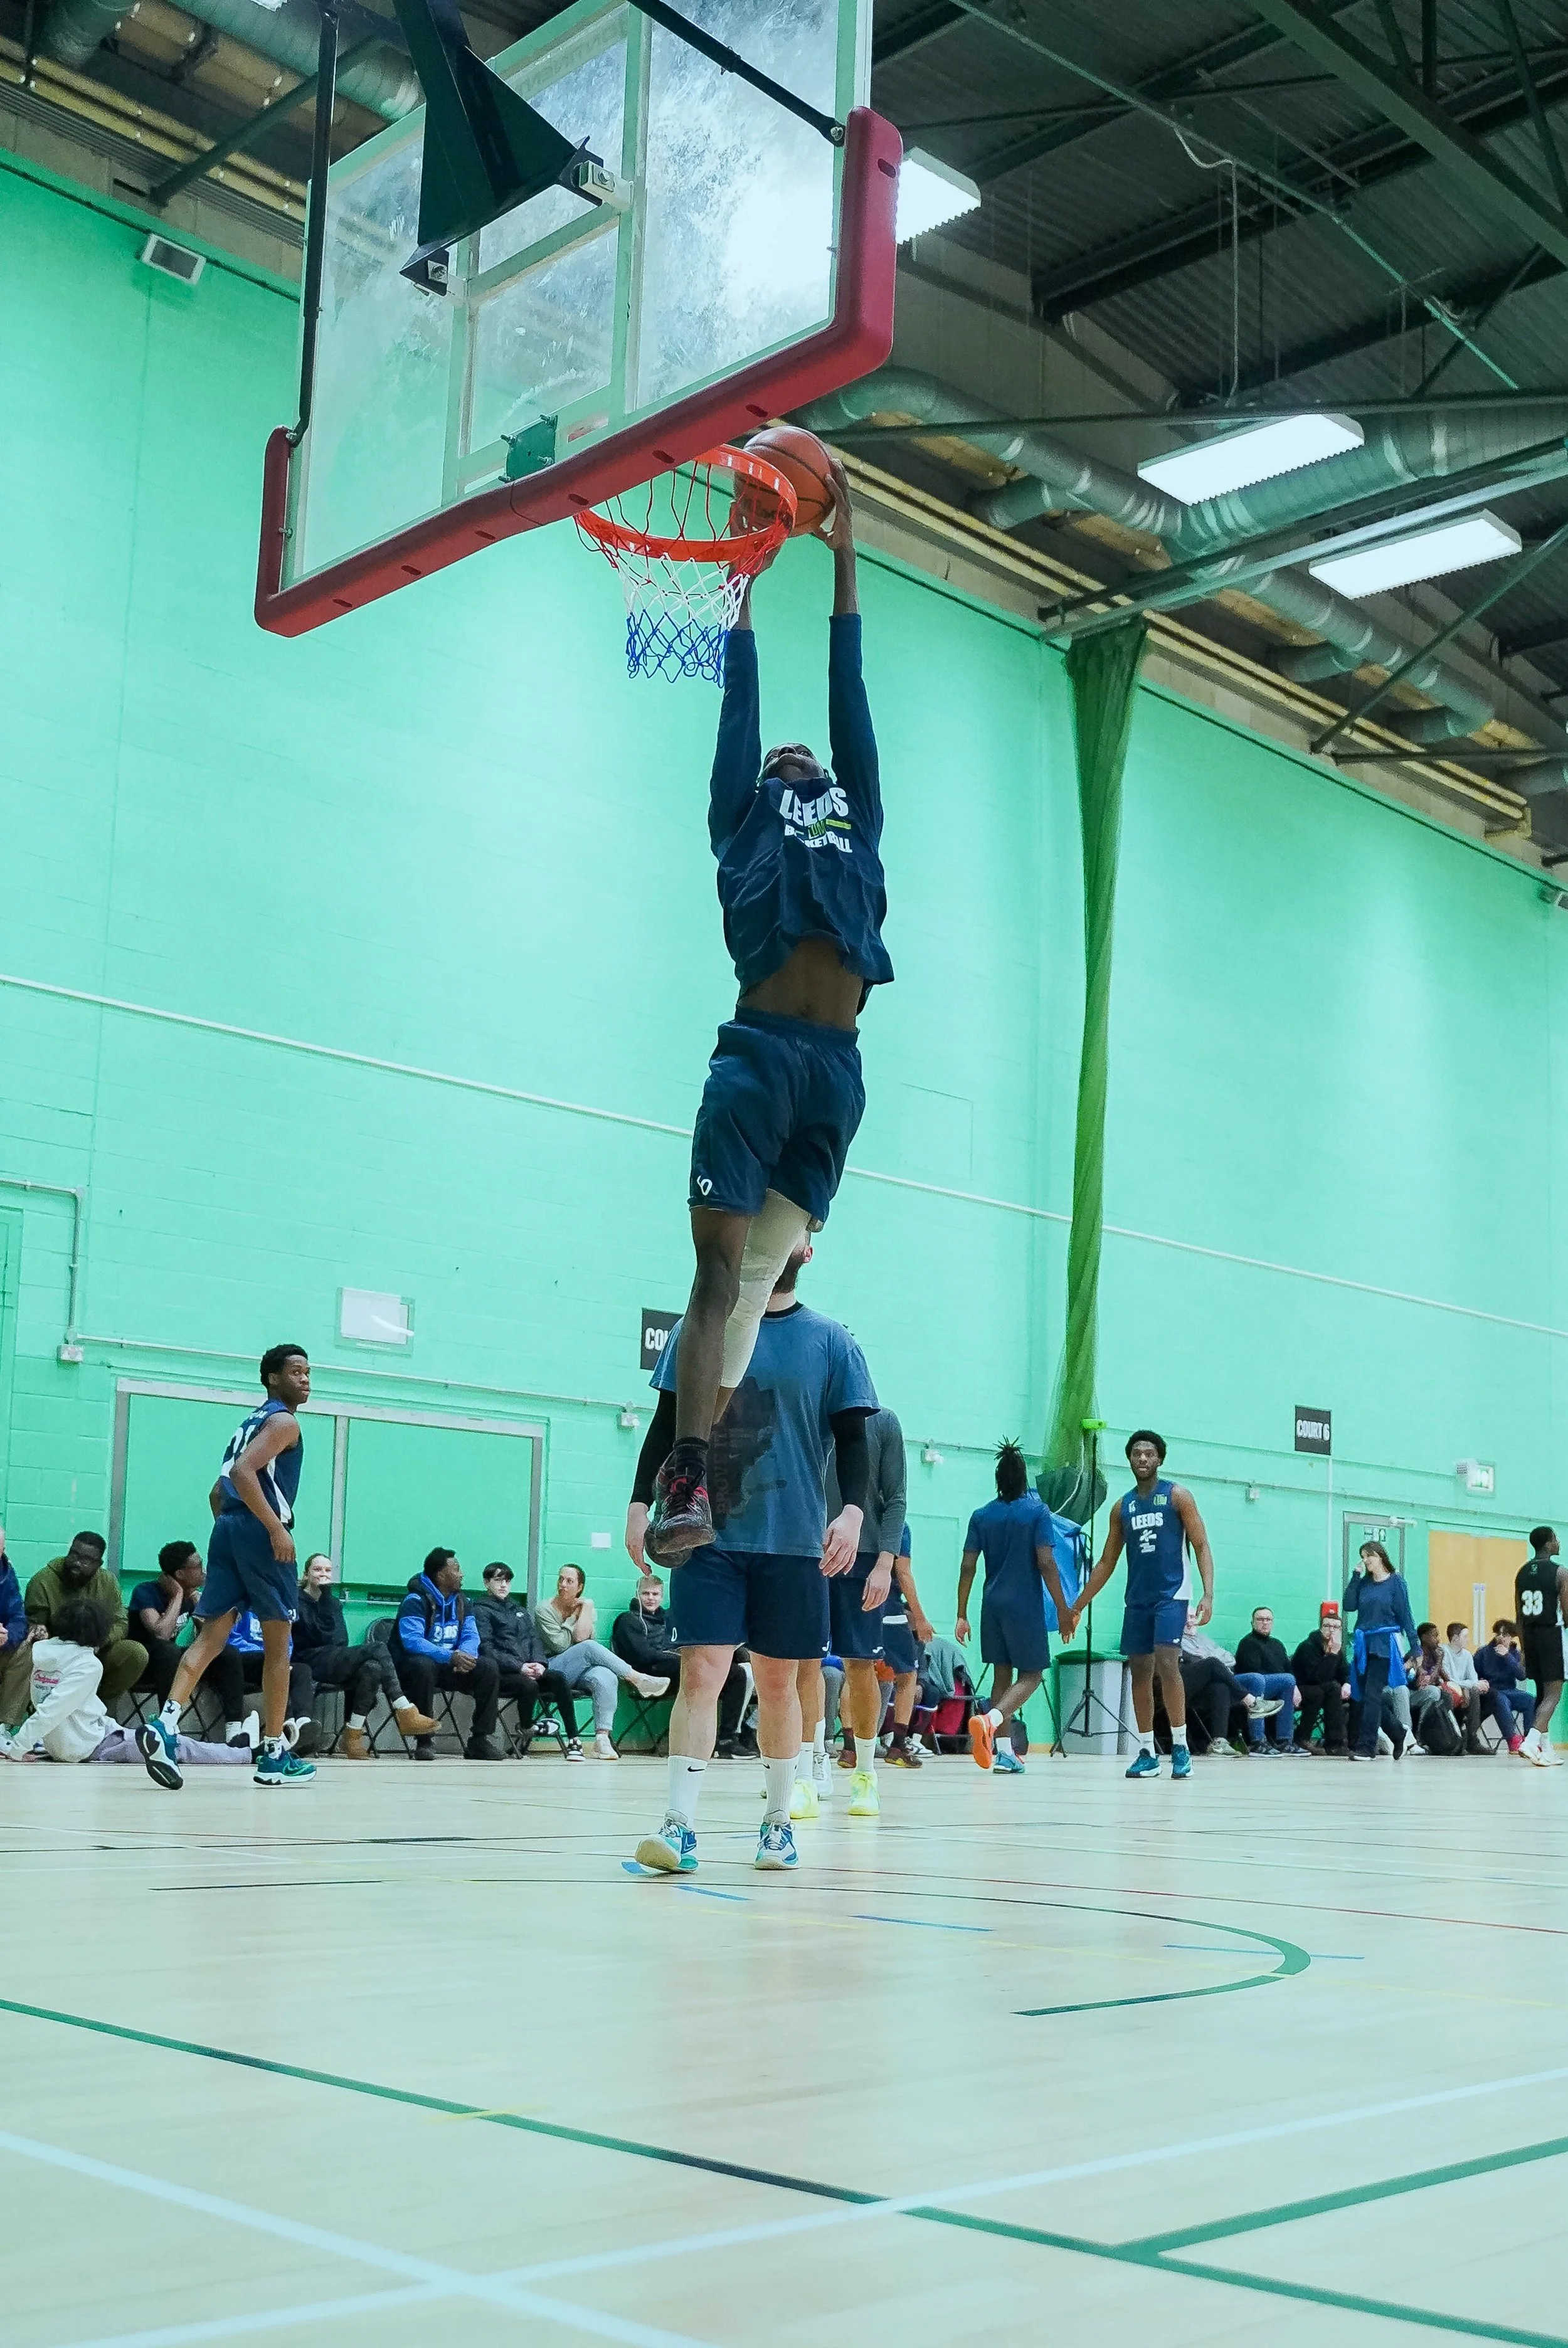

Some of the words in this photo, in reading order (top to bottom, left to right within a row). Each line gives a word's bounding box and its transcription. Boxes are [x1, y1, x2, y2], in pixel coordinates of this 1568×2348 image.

[779, 787, 849, 827] LEEDS
[784, 824, 853, 854] BKETBALL
[1296, 1419, 1323, 1440] COURT
[1323, 1423, 1330, 1441] 6
[1131, 1512, 1163, 1530] LEEDS
[1522, 1590, 1544, 1616] 33
